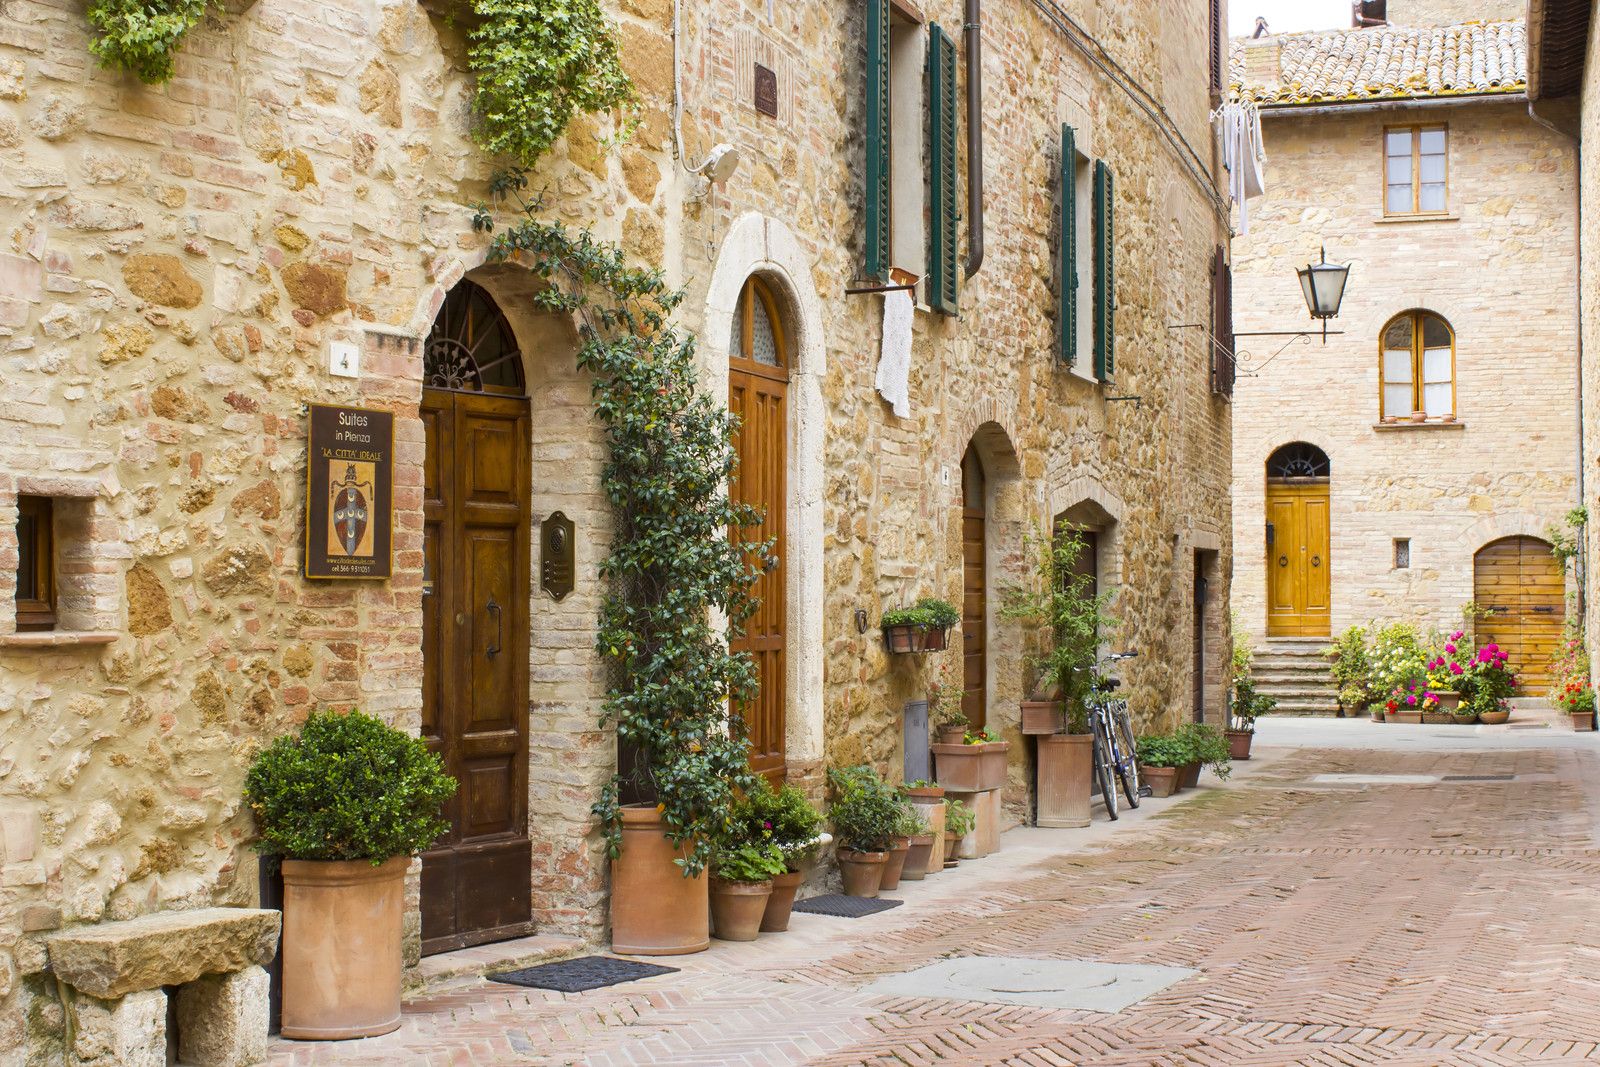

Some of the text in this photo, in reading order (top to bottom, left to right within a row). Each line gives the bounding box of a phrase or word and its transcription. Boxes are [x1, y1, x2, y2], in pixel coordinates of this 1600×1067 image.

[340, 352, 349, 369] 4
[339, 412, 368, 427] Suites
[335, 430, 371, 443] in Pienza
